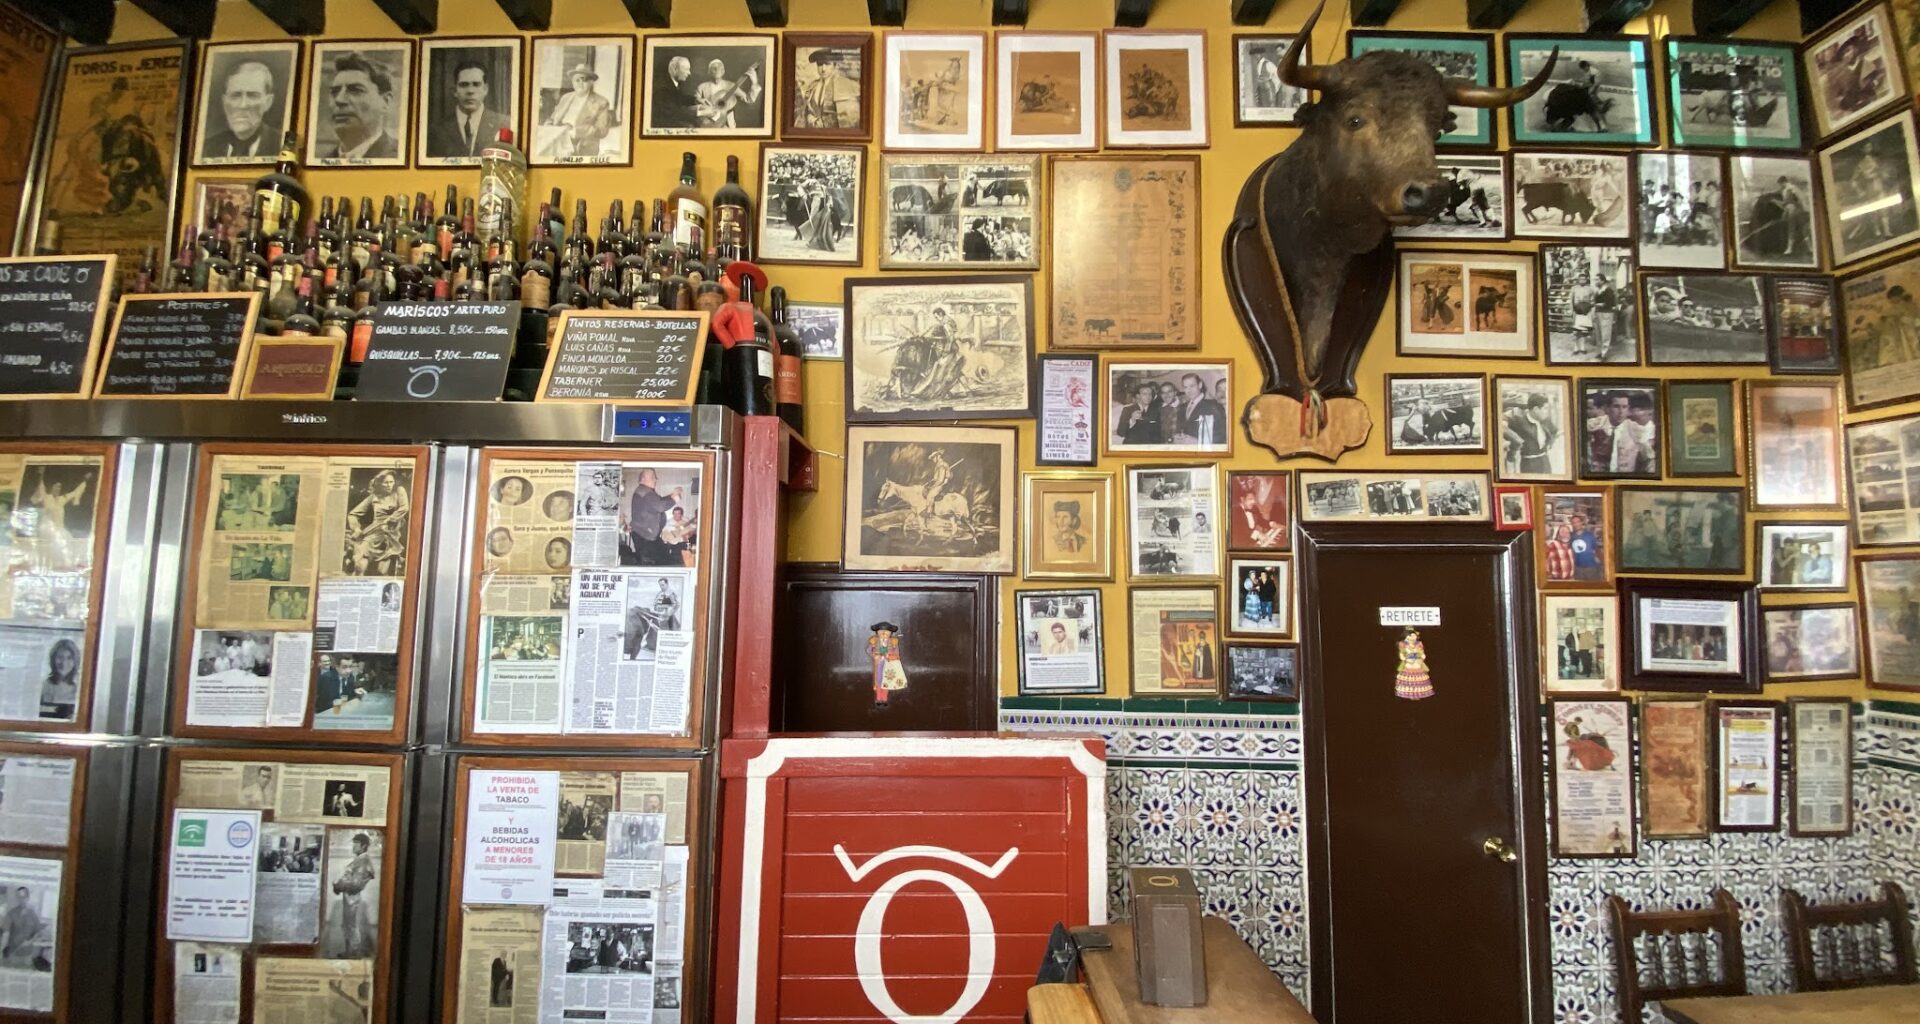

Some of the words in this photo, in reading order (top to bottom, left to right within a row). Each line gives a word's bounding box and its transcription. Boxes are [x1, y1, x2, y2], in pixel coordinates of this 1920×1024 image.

[73, 60, 117, 75] TOROS
[136, 56, 181, 71] JEREZ
[167, 300, 222, 310] POSTRES
[384, 305, 450, 317] MARISCOS
[568, 318, 601, 328] TINTOS
[604, 320, 650, 329] RESERVAS
[654, 321, 697, 330] BOTELLAS
[376, 325, 408, 334] GAMBAS
[409, 325, 440, 335] BLANCAS
[448, 324, 474, 335] 8,50€
[567, 331, 588, 341] VIÑA
[589, 333, 618, 342] POMAL
[565, 344, 585, 352] LUIS
[586, 342, 614, 352] CAÑAS
[369, 349, 420, 360] QUISQUILLAS
[434, 350, 461, 361] 7,90€
[561, 354, 587, 363] FINCA
[587, 354, 627, 363] MONCLOA
[609, 366, 638, 375] RISCAL
[554, 377, 603, 386] TABERNER
[641, 378, 678, 388] 25,00€
[549, 387, 592, 397] BERONIA
[580, 574, 590, 582] UN
[592, 574, 608, 582] ARTE
[610, 574, 623, 583] QUE
[579, 582, 589, 590] NO
[591, 583, 600, 591] SE
[1386, 610, 1433, 622] RETRETE
[491, 776, 536, 785] PROHIBIDA
[500, 786, 526, 794] VENTA
[528, 786, 539, 794] DE
[496, 795, 529, 804] TABACO
[508, 817, 514, 825] Y
[492, 826, 529, 835] BEBIDAS
[481, 836, 540, 845] ALCOHOLICAS
[493, 846, 534, 854] MENORES
[485, 856, 496, 864] DE
[498, 856, 508, 864] 18
[510, 855, 533, 864] AÑOS
